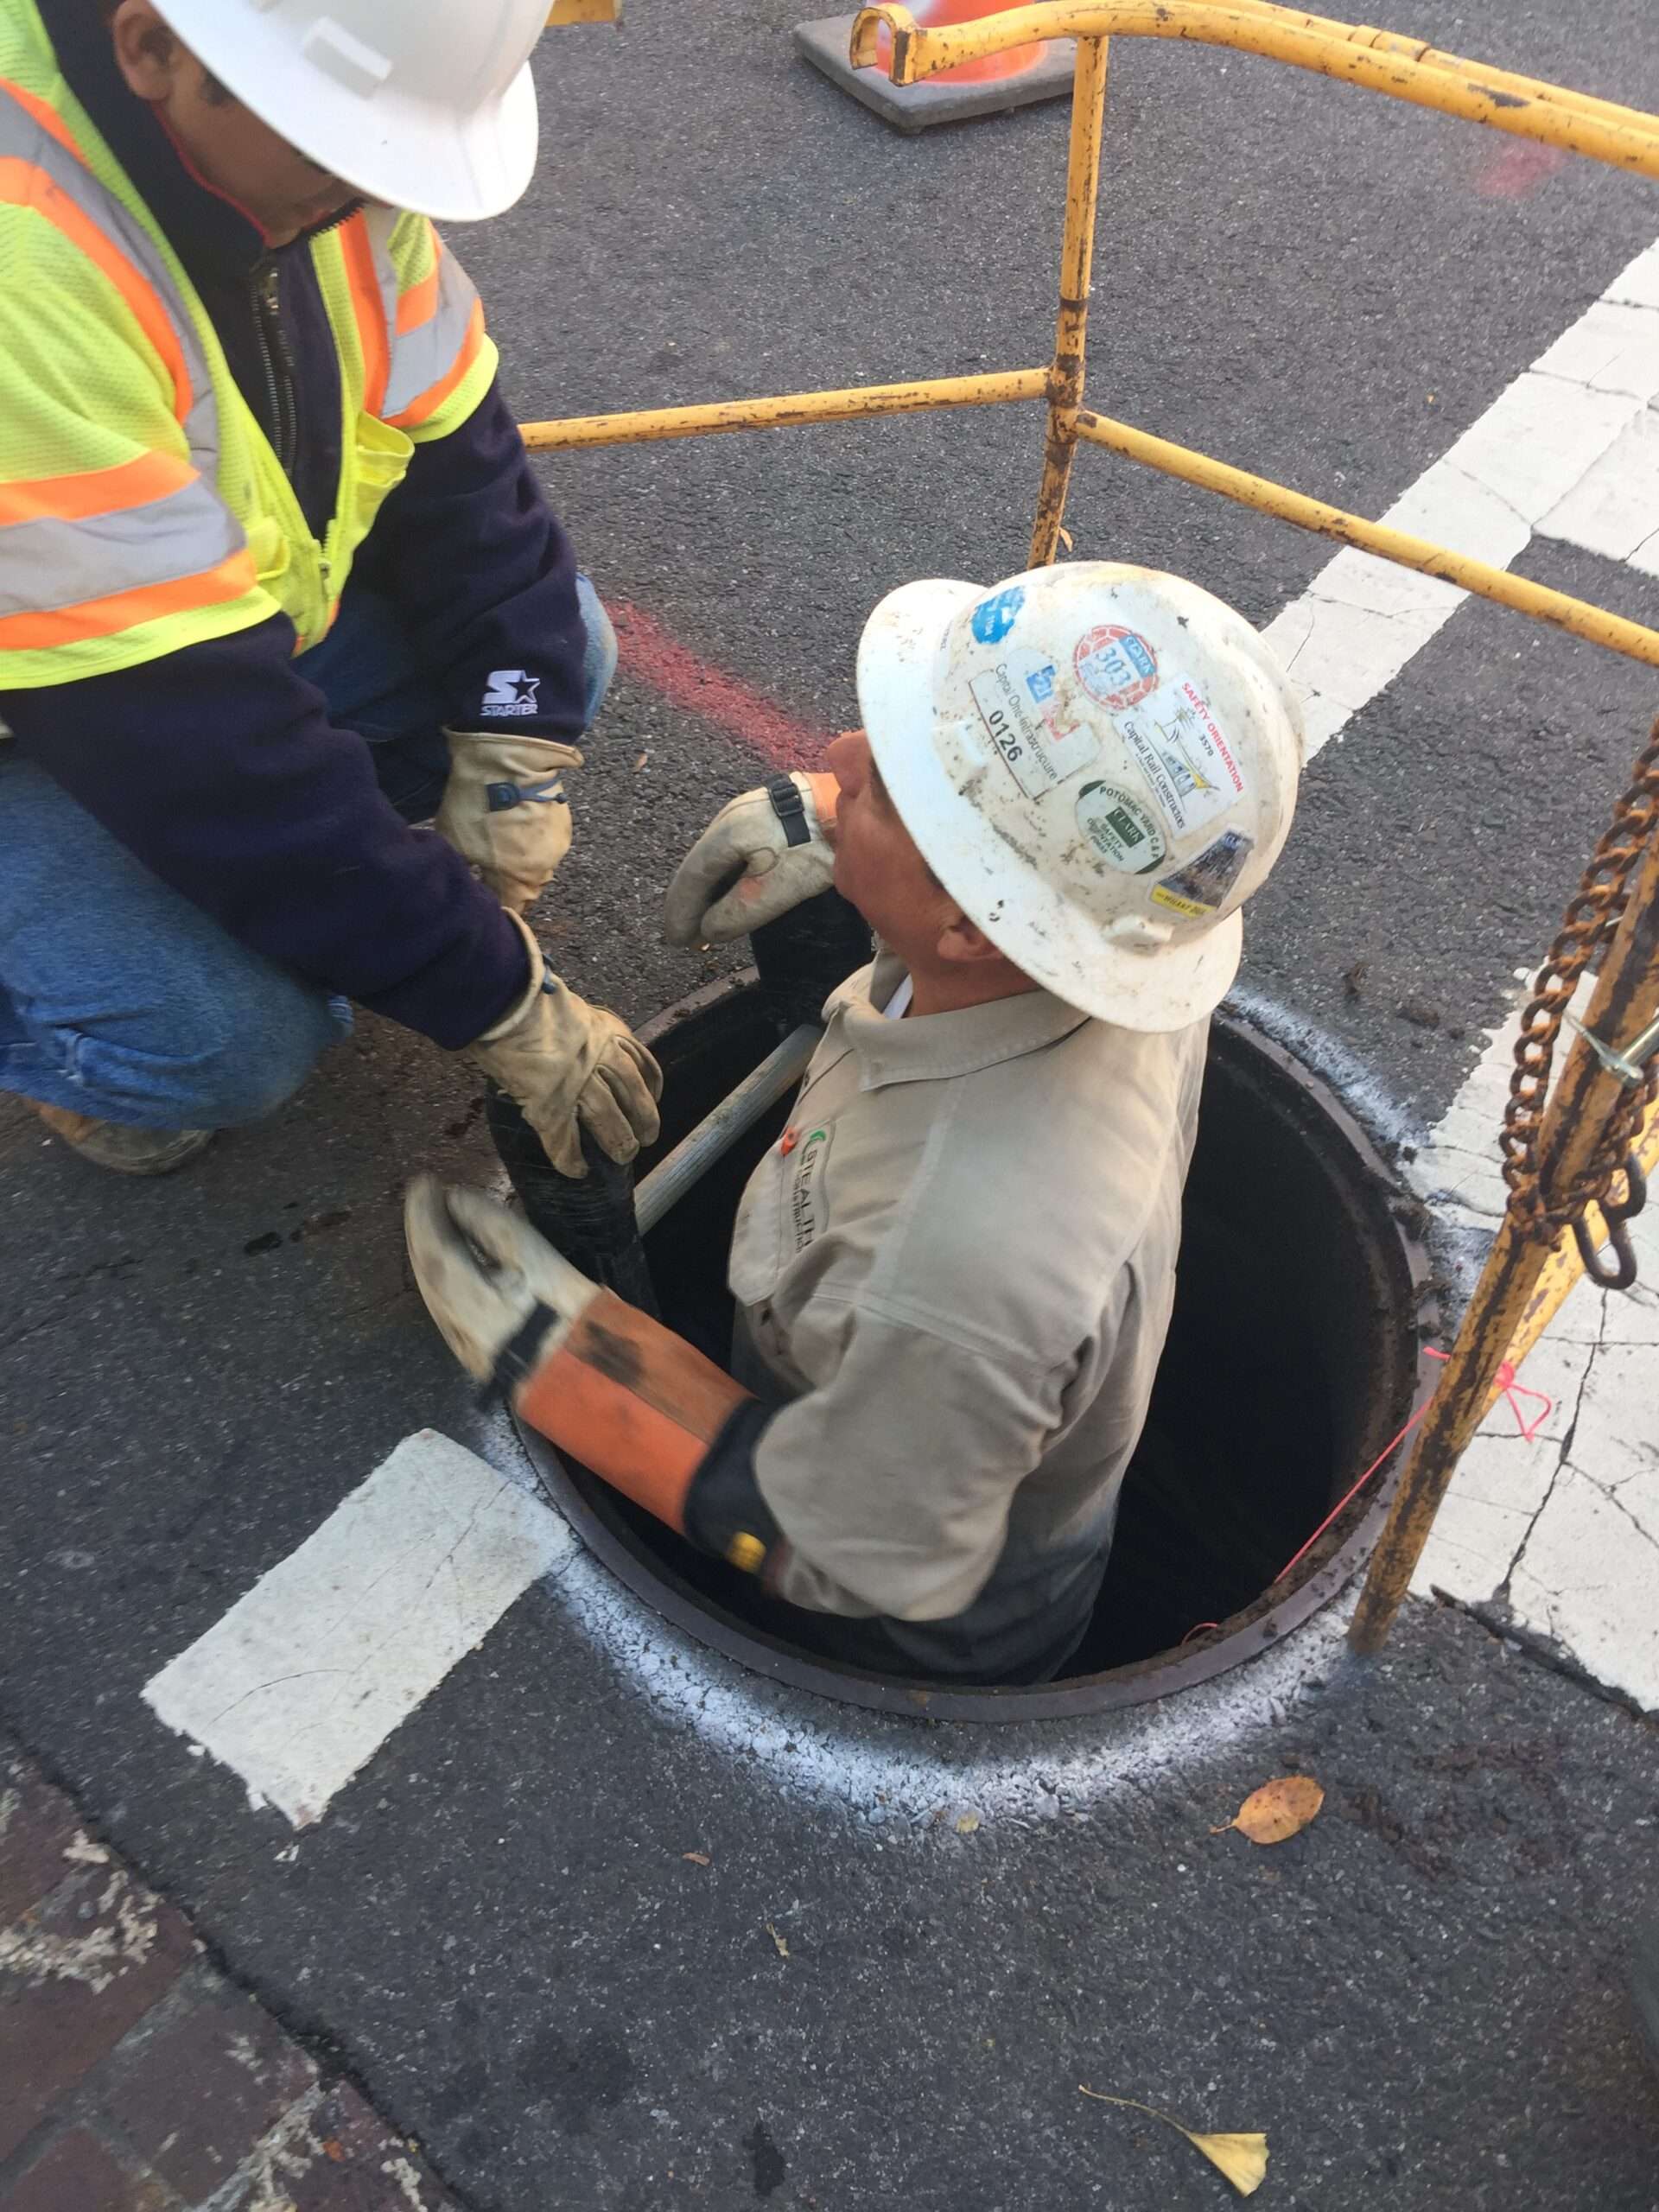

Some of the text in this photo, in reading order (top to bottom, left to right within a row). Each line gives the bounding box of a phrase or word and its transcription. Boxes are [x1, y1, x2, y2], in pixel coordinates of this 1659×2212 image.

[1095, 648, 1131, 685] 303
[480, 704, 538, 716] STARTER
[1009, 695, 1025, 718] One
[988, 710, 1023, 761] 0126
[1182, 683, 1244, 792] SAFETY ORIENTATION
[1124, 721, 1149, 754] Capital
[1144, 753, 1162, 775] Rail
[1157, 774, 1185, 830] Constructors
[1099, 786, 1143, 816] POTOMAC
[1140, 813, 1156, 836] YARD
[1113, 808, 1141, 842] CLARK
[1087, 817, 1126, 862] ONTATION
